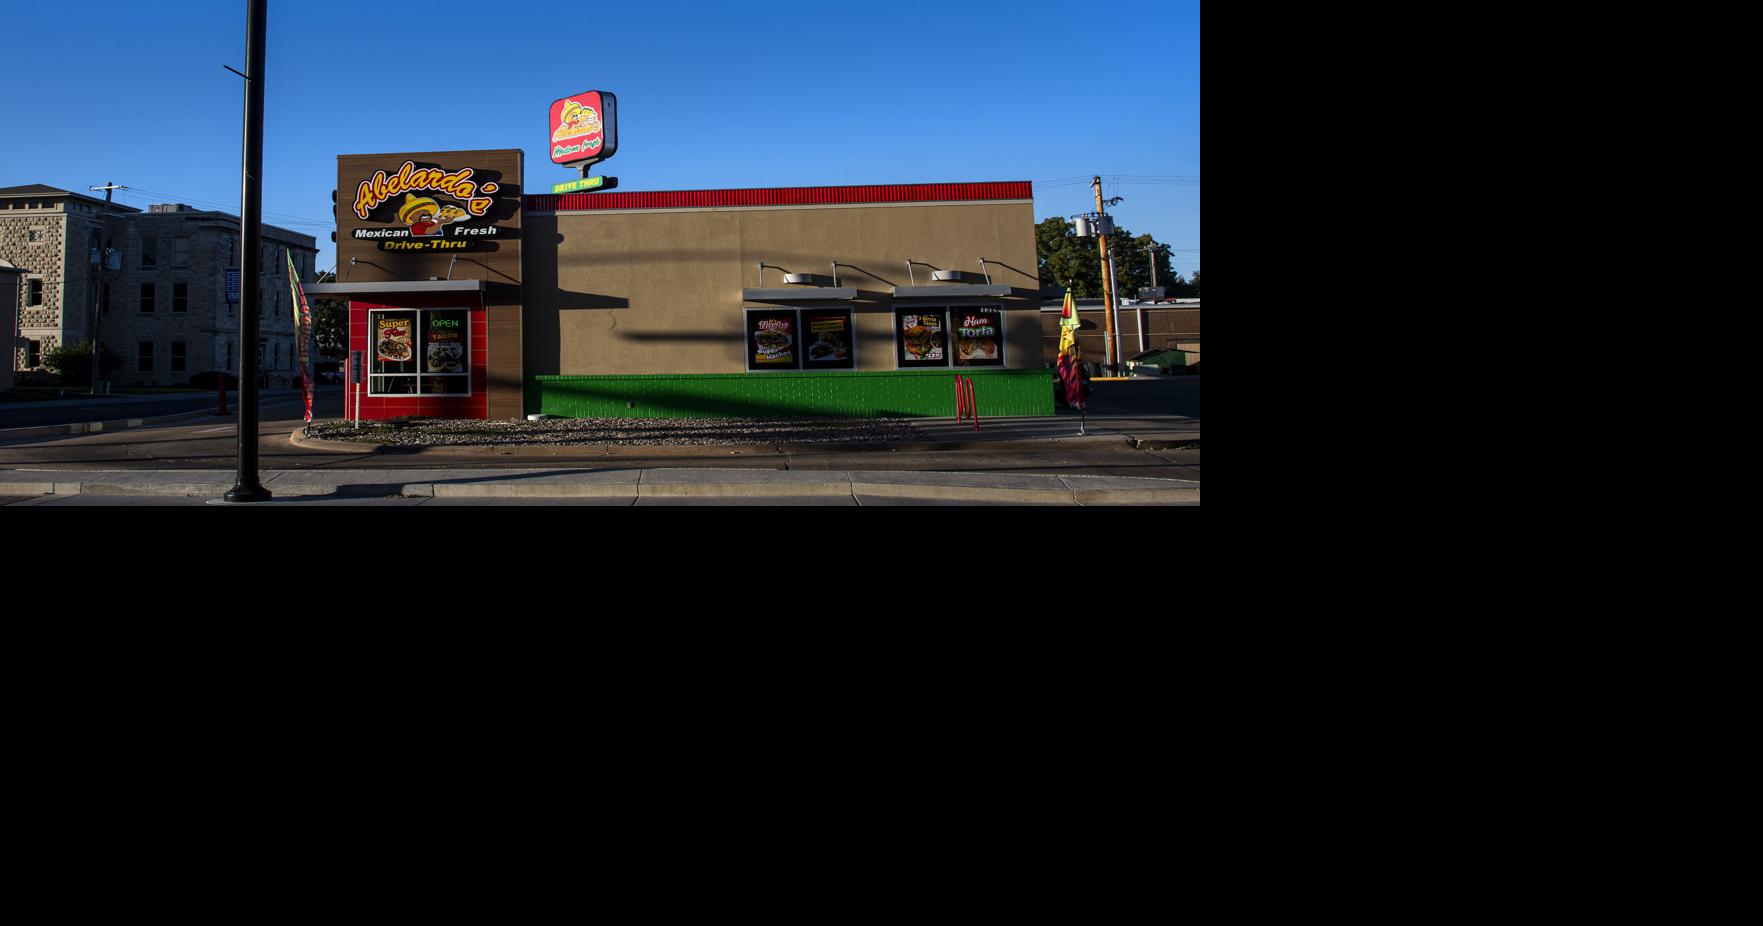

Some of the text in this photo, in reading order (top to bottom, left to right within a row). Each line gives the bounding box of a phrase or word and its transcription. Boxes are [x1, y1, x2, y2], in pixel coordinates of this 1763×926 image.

[553, 176, 599, 193] DRIVE THRU
[355, 226, 497, 238] Mexican Fresh
[384, 240, 467, 250] Drive-Thru
[379, 320, 409, 329] Super
[432, 320, 459, 328] OPEN
[964, 316, 987, 326] Ham
[959, 326, 993, 337] Torta
